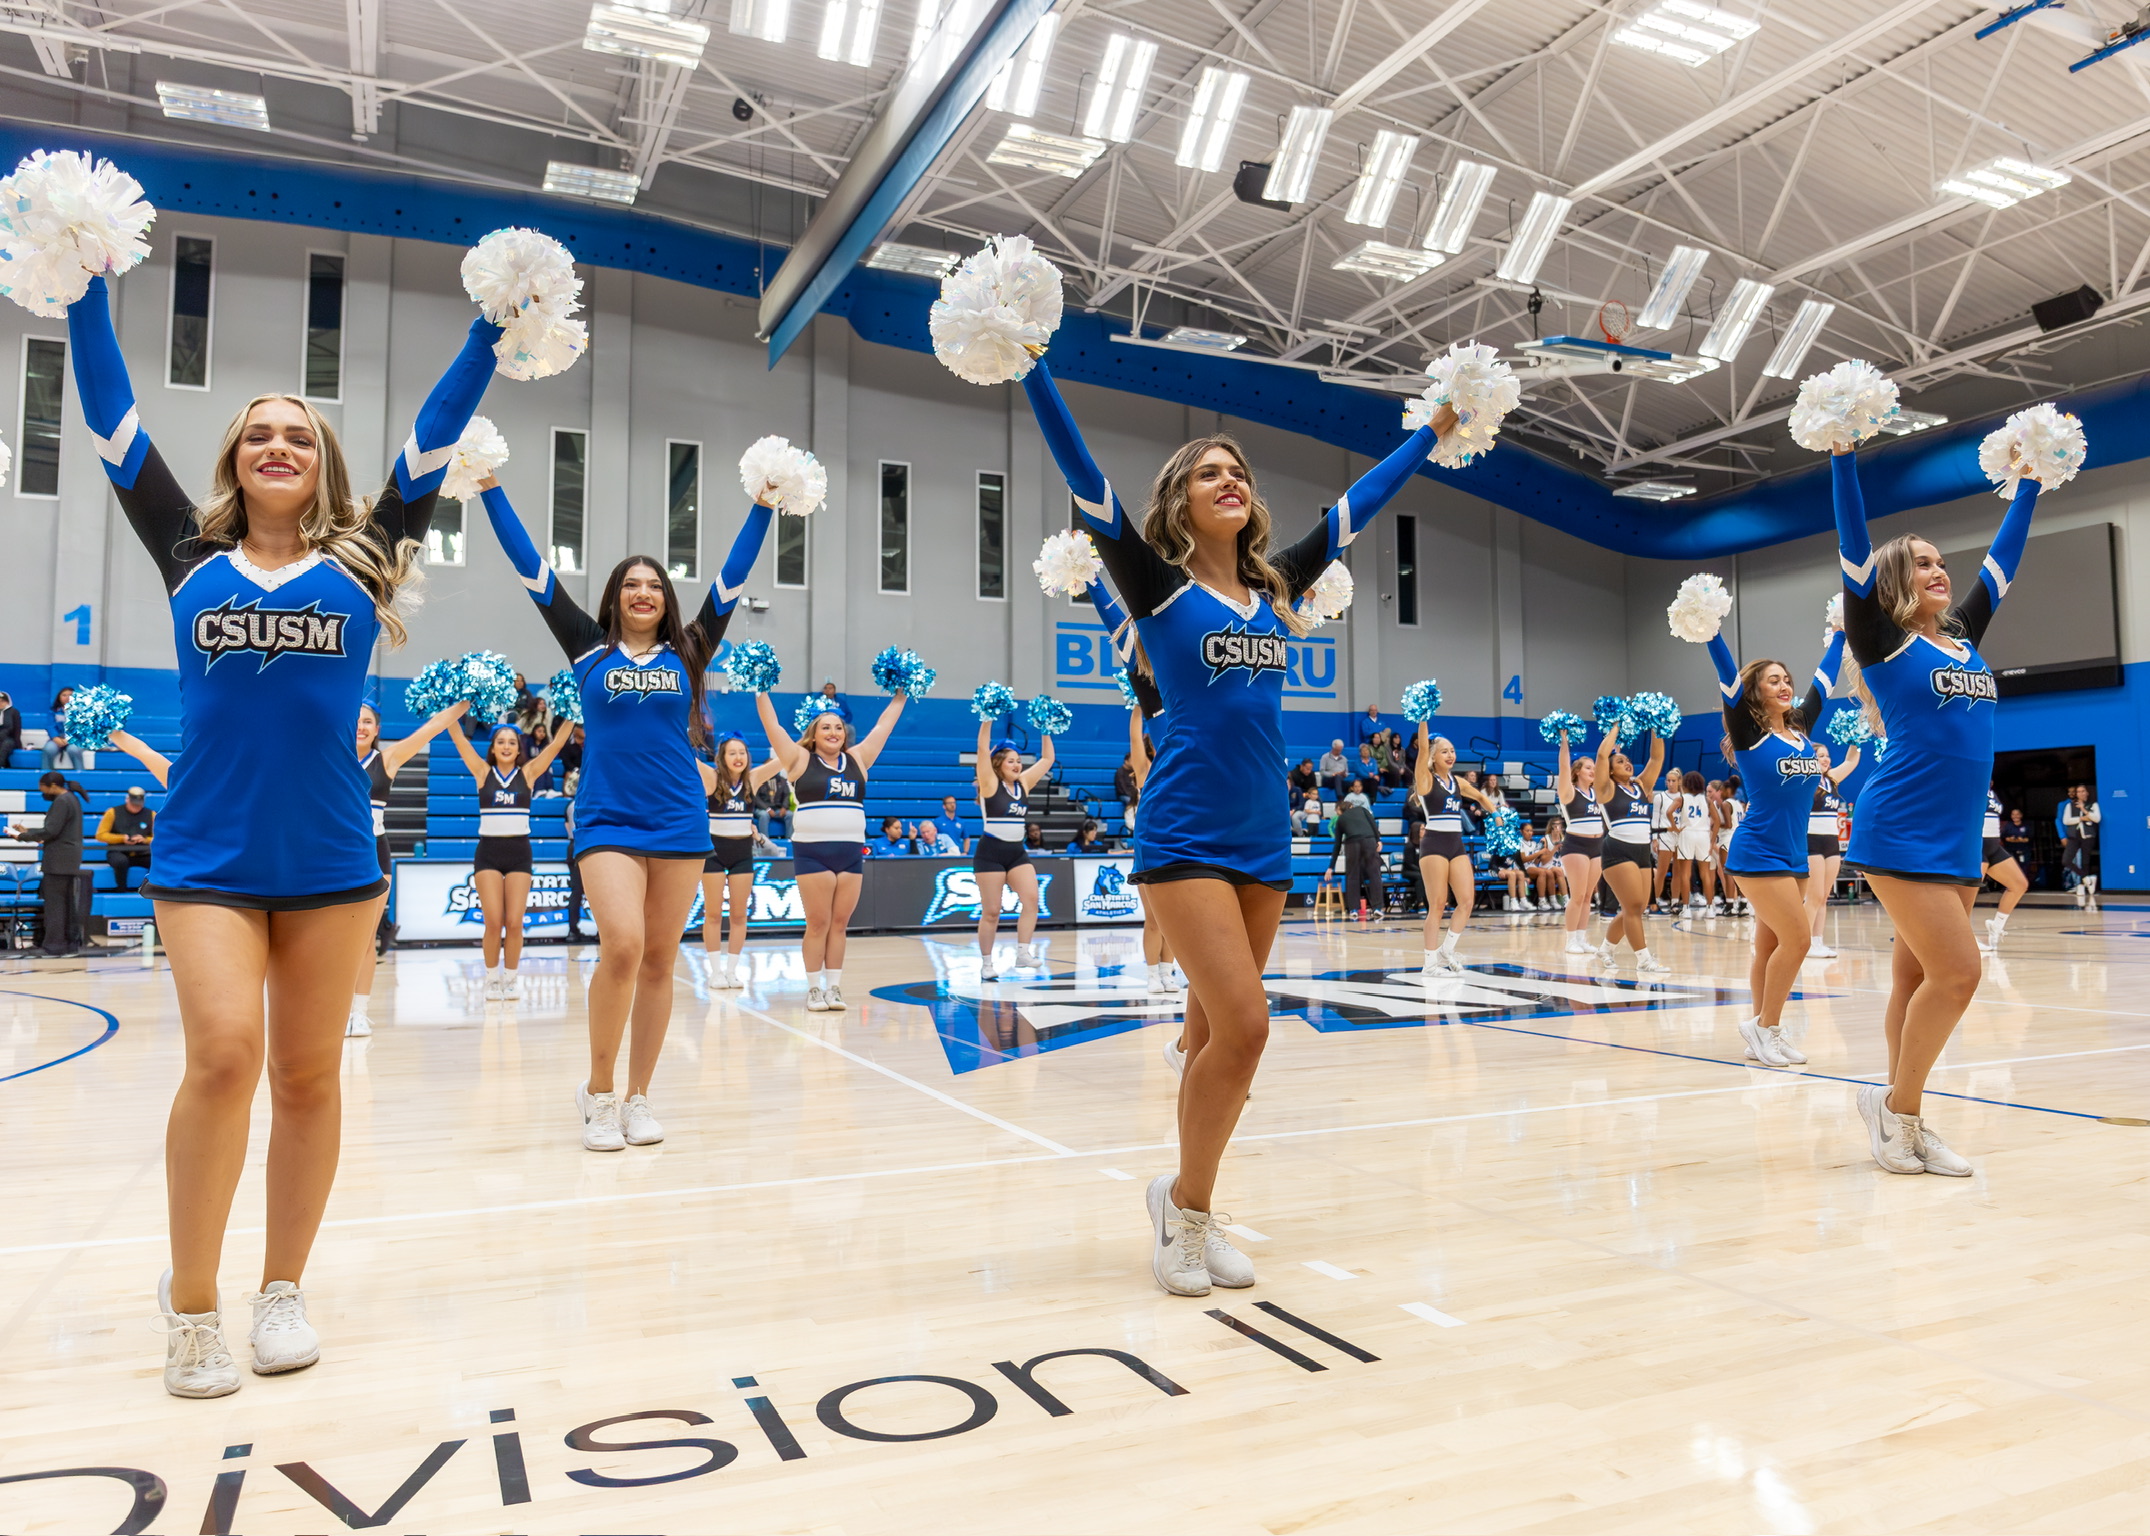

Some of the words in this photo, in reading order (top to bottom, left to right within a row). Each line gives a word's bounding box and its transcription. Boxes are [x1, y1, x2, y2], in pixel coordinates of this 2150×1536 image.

[64, 604, 91, 645] 1
[197, 609, 342, 653] CSUSM
[705, 638, 733, 673] 2
[1205, 633, 1288, 668] CSUSM
[1056, 633, 1119, 678] BL
[1286, 646, 1337, 689] RU
[606, 669, 679, 693] CSUSM
[1502, 674, 1523, 705] 4
[829, 776, 857, 798] SM
[494, 789, 516, 805] SM
[726, 799, 745, 812] SM
[1445, 797, 1461, 812] SM
[1824, 795, 1840, 809] SM
[1008, 802, 1028, 816] SM
[1630, 801, 1649, 815] SM
[1688, 805, 1702, 818] 24
[1083, 900, 1102, 910] SAN
[1102, 899, 1138, 910] MARCOS
